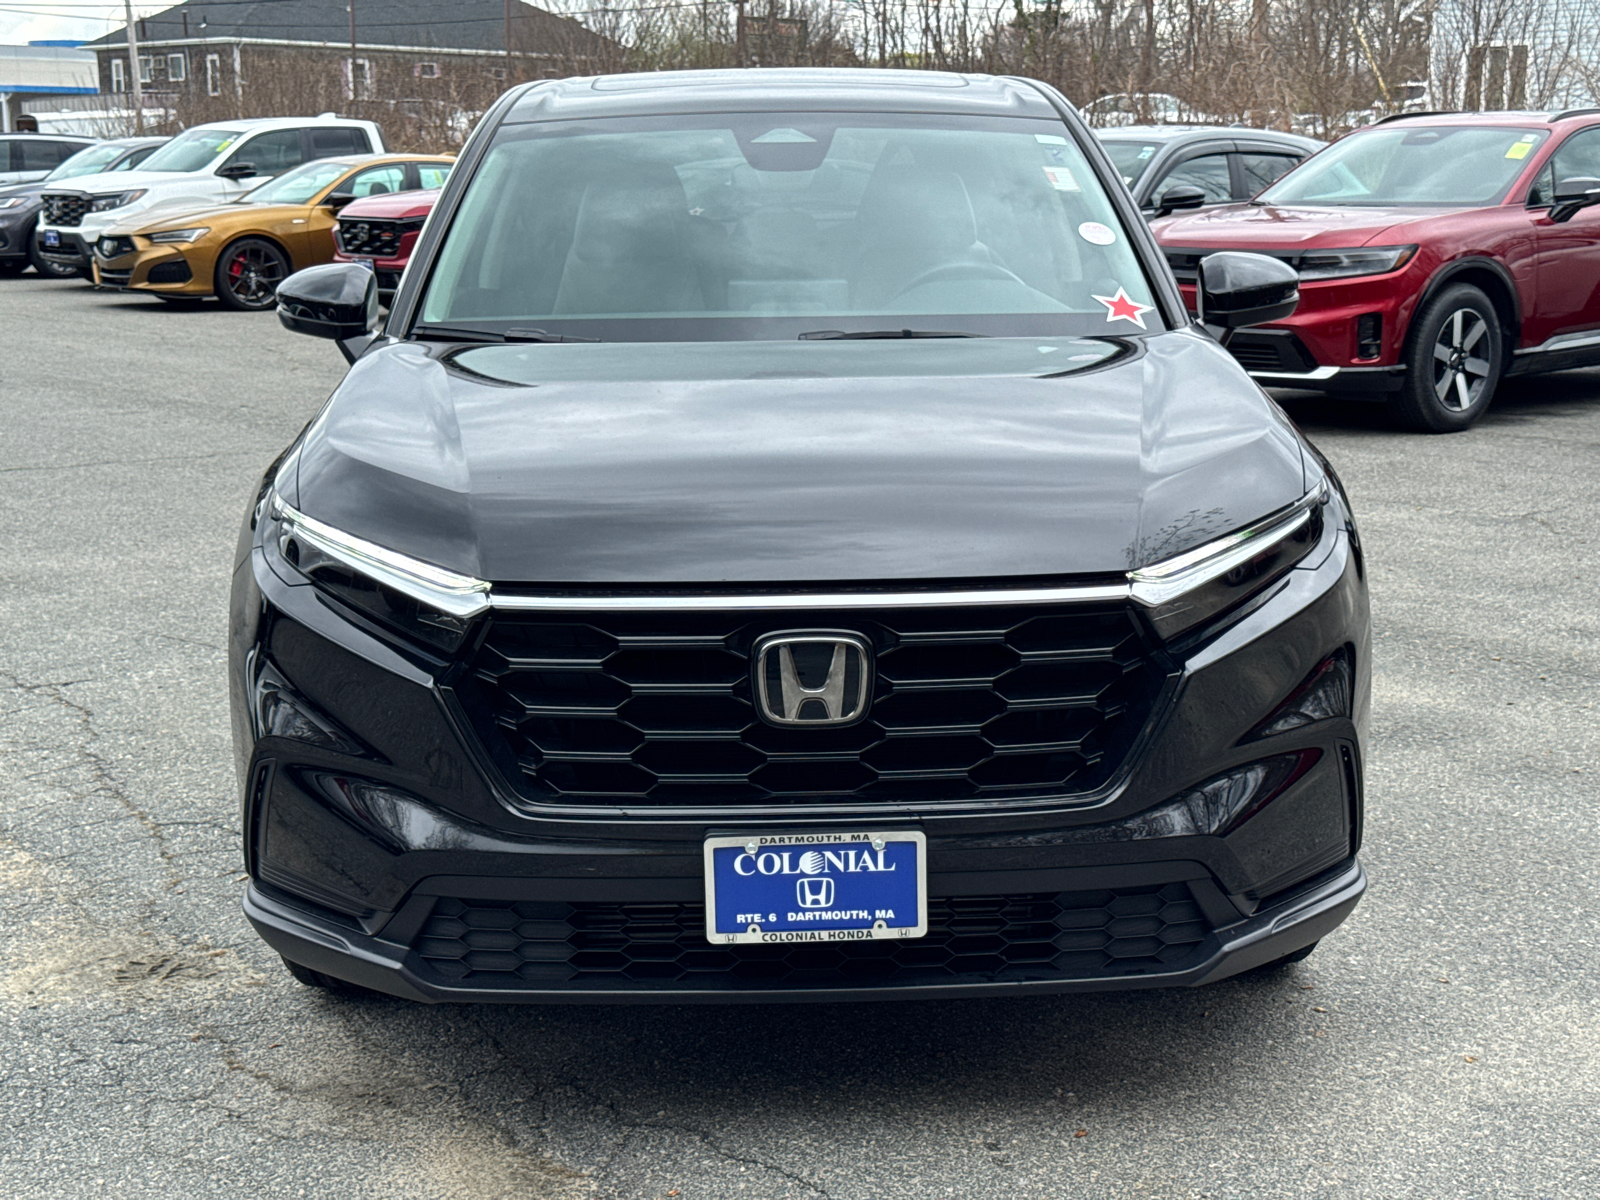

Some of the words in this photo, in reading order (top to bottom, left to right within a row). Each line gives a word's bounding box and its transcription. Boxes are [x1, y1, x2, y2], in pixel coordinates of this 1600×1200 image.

[759, 834, 846, 845] DARTMOUTH,
[850, 833, 871, 842] MA
[733, 849, 897, 876] COLONIAL
[736, 913, 766, 924] RTE.
[768, 912, 778, 923] 6
[787, 909, 873, 922] DARTMOUTH,
[874, 909, 896, 919] MA
[761, 931, 824, 942] COLONIAL
[827, 929, 874, 940] HONDA
